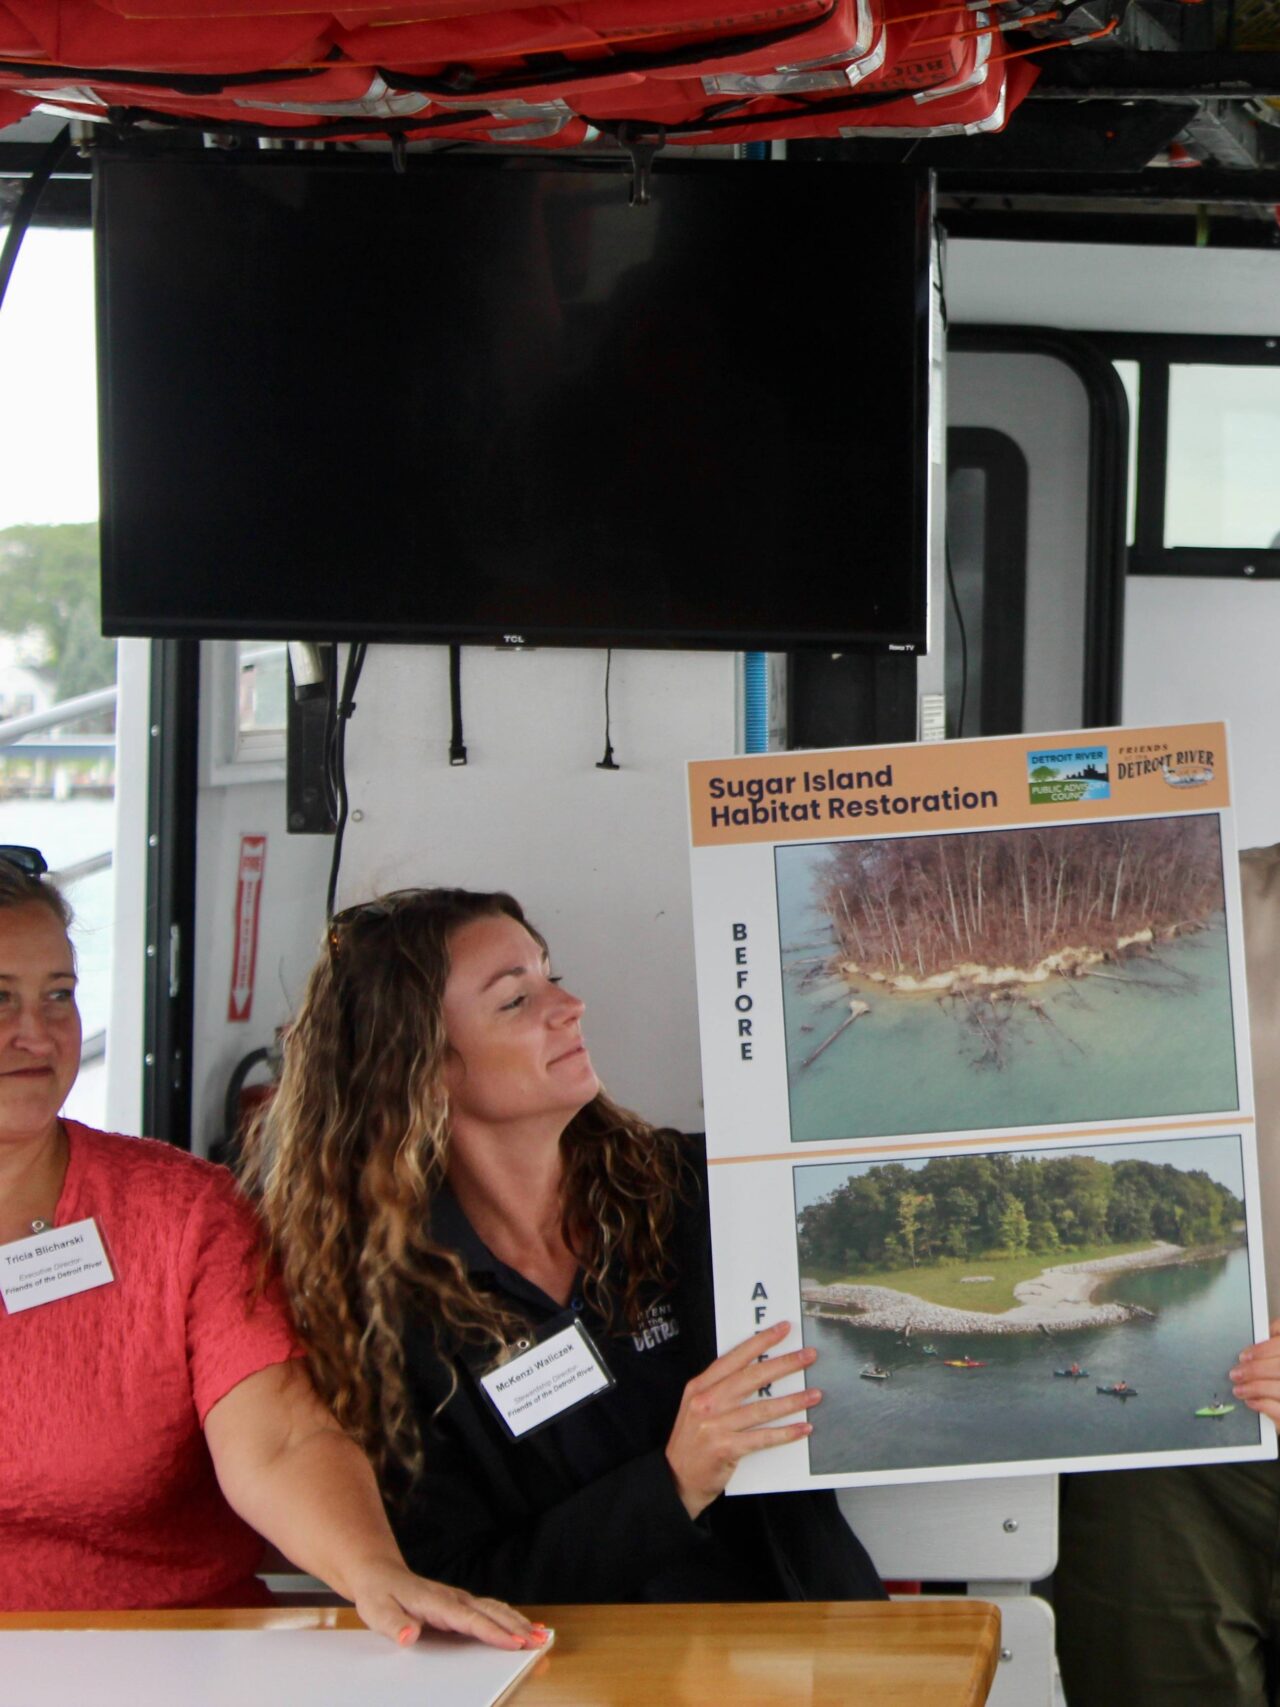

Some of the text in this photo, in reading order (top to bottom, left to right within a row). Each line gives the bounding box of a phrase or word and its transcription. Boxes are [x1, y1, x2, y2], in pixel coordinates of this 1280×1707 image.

[503, 635, 525, 643] TCL
[1031, 751, 1104, 764] DETROIT RIVER
[1118, 750, 1214, 779] DETROIT RIVER
[1119, 744, 1168, 754] FRIENDS
[708, 764, 893, 800] Sugar Island
[1031, 785, 1062, 795] PUBLIC
[711, 787, 998, 827] Habitat Restoration
[732, 923, 753, 1061] BEFORE
[6, 1234, 84, 1265] Tricia Blicharski
[6, 1260, 102, 1295] Friends of the Detroit River
[751, 1282, 773, 1397] AFR
[496, 1343, 574, 1392] McKenzi Waliczek
[508, 1364, 594, 1418] Friends of the Detroit River
